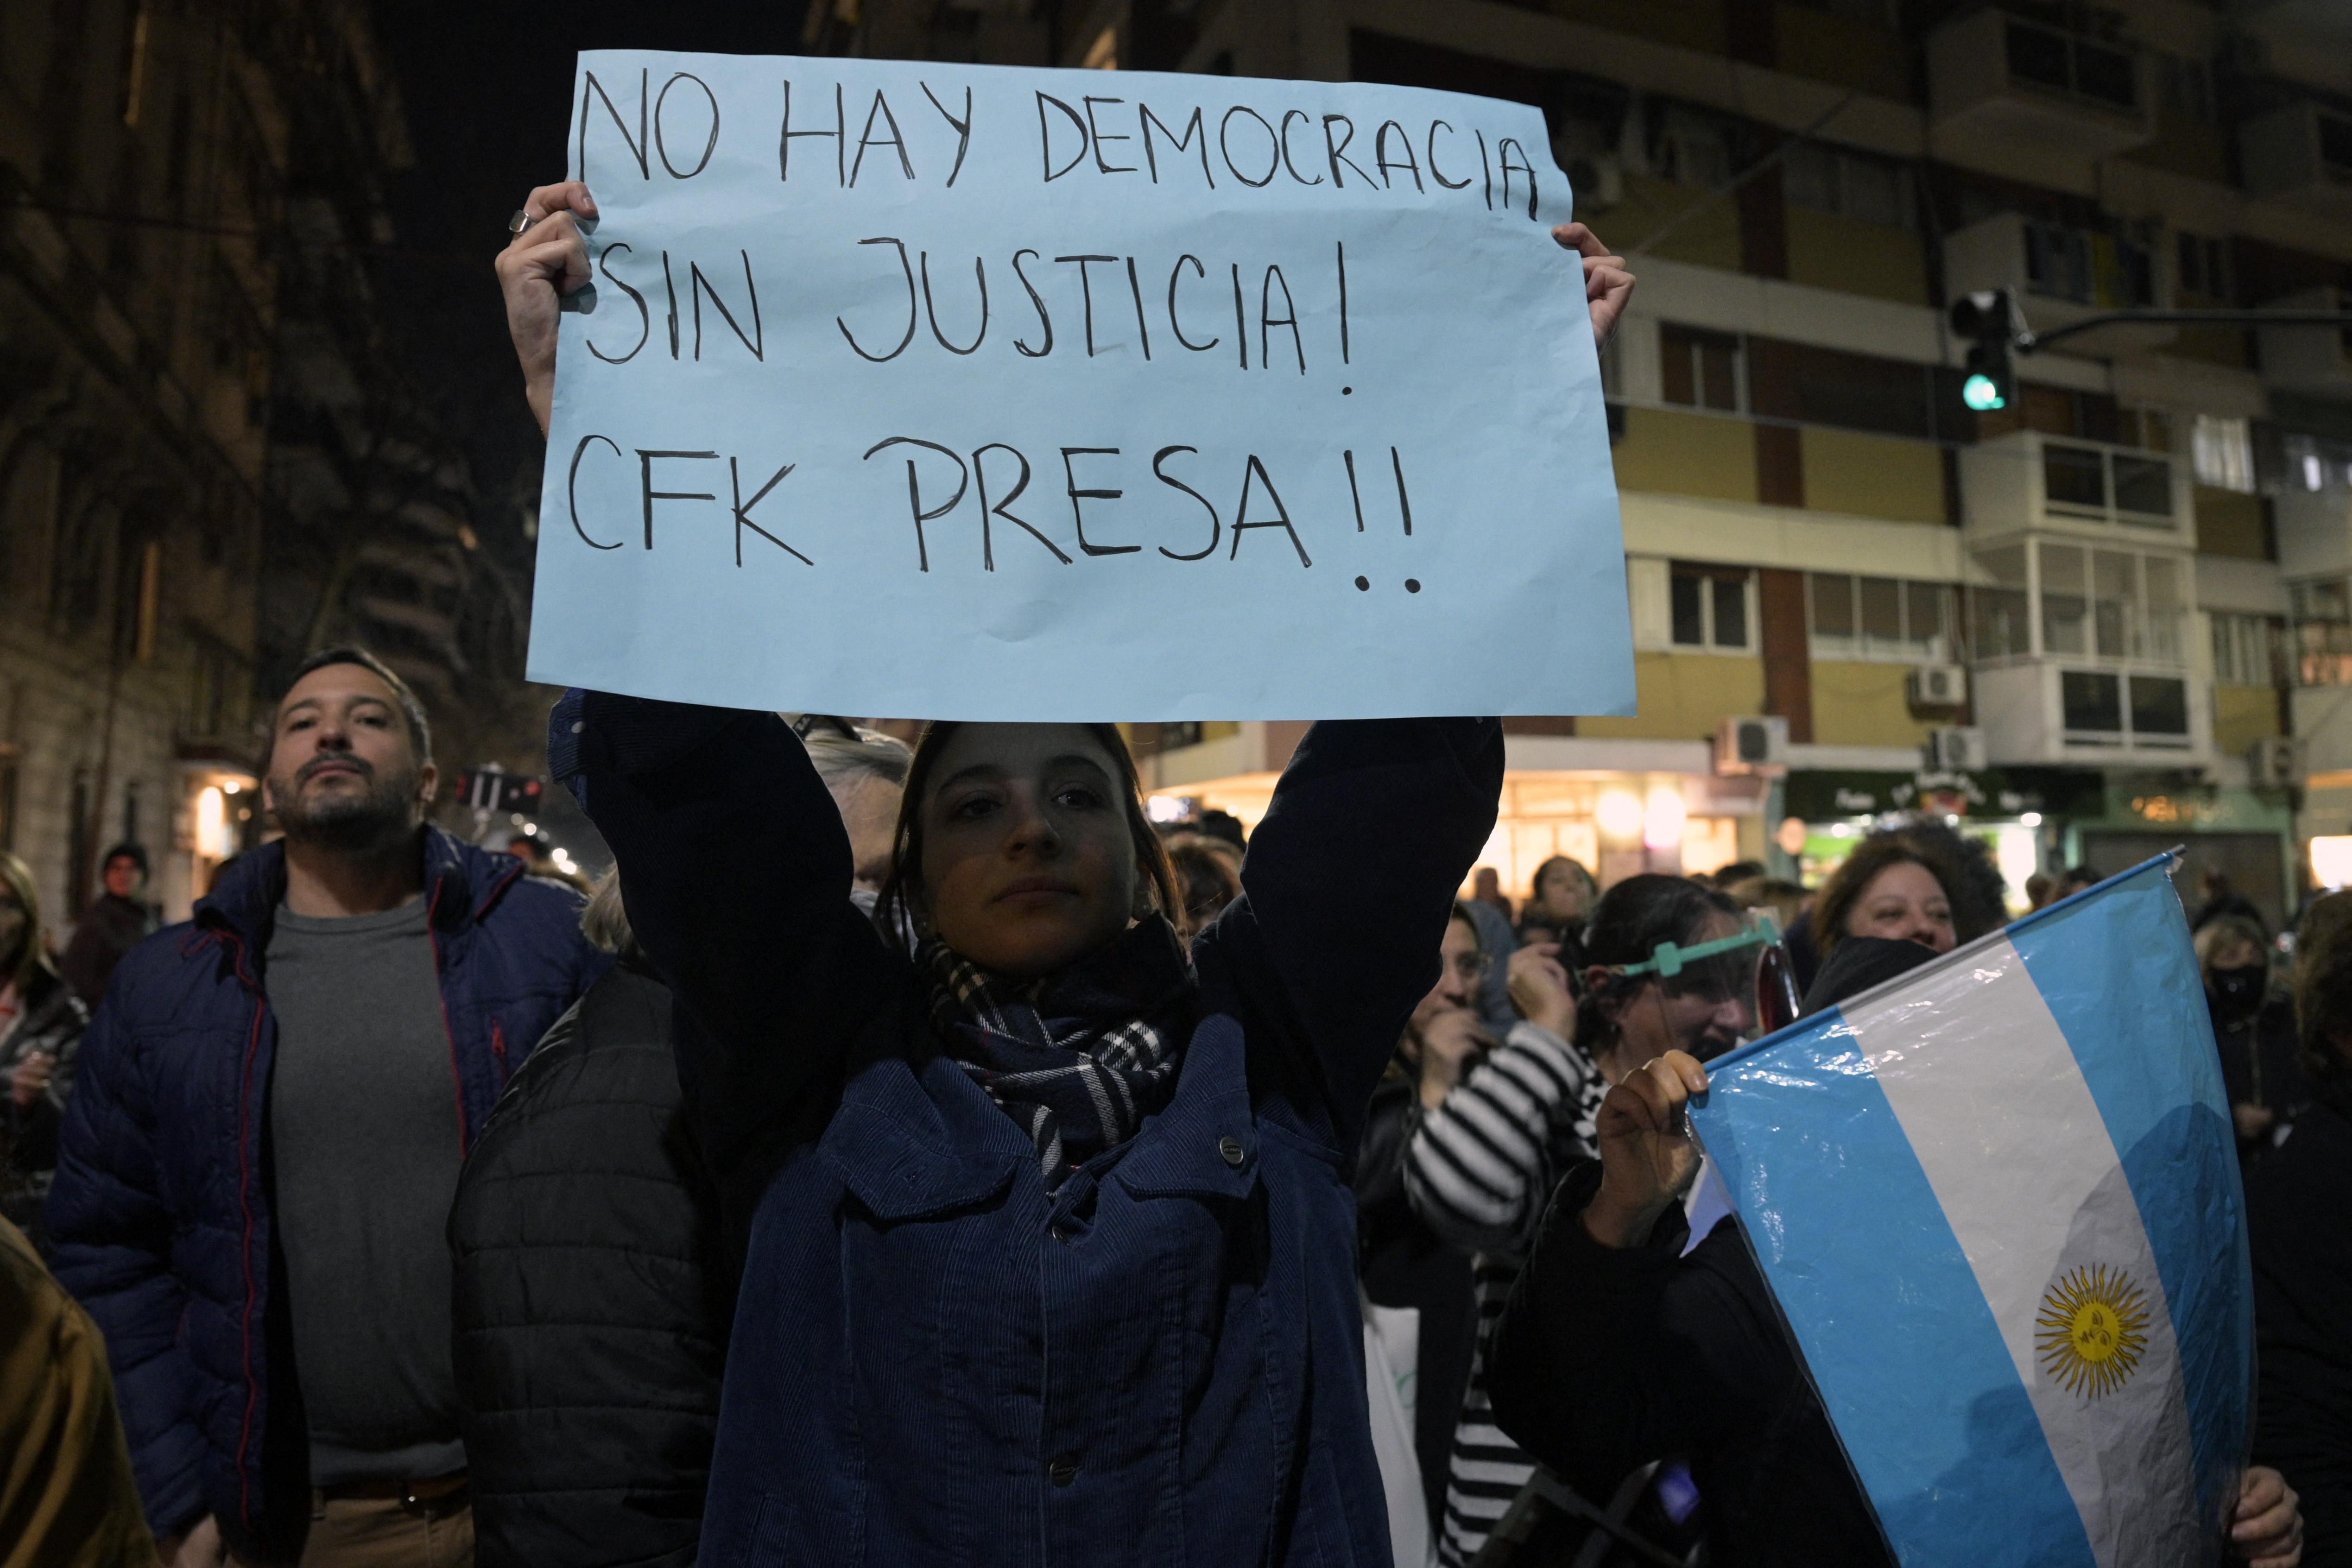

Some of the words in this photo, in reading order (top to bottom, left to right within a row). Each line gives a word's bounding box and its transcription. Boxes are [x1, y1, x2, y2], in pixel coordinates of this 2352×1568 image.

[580, 68, 719, 183] NO
[780, 80, 971, 188] HAY
[1035, 89, 1538, 221] DEMOCRACIA
[586, 242, 763, 364] SIN
[837, 237, 1352, 395] JUSTICIA!
[569, 435, 814, 568] CFK
[863, 436, 1421, 594] PRESA!!
